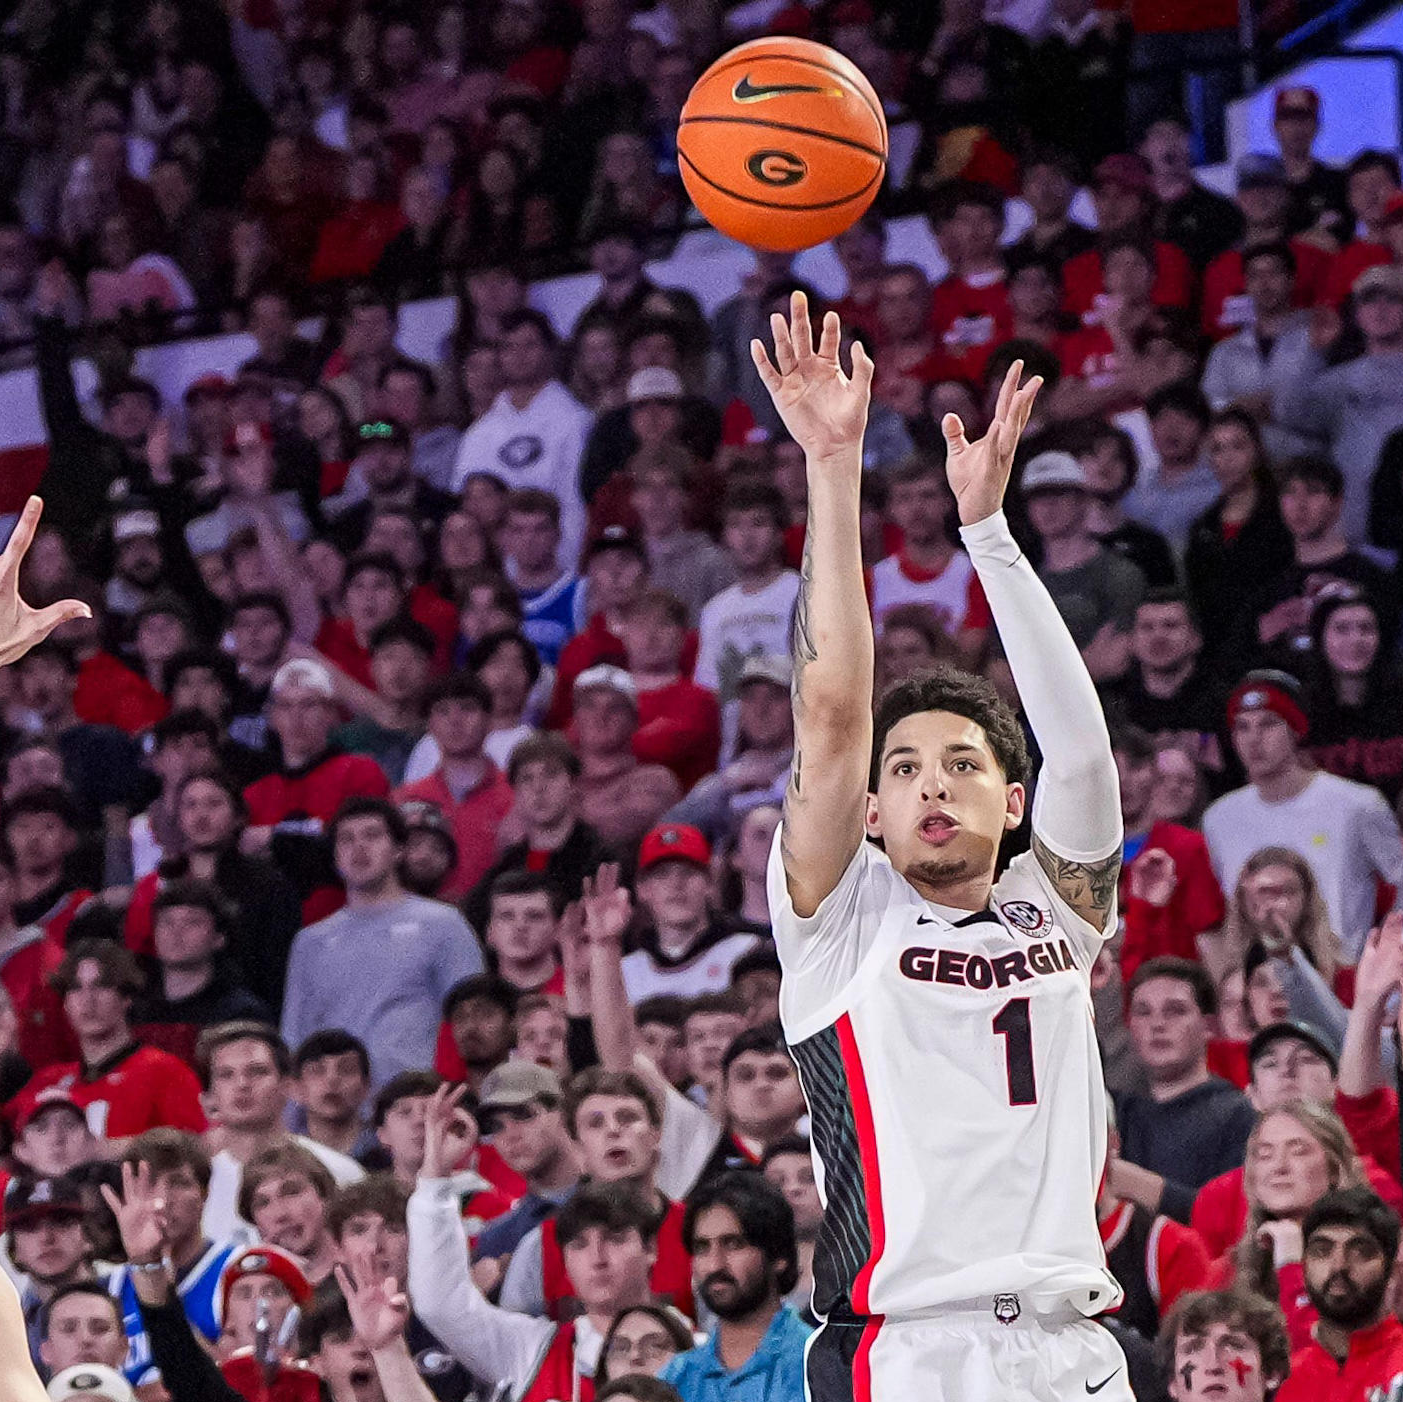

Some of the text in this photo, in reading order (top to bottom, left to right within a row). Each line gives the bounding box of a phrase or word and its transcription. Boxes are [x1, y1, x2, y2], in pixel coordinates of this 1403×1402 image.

[743, 148, 809, 188] G
[899, 939, 1080, 990] GEORGIA
[992, 997, 1038, 1106] 1
